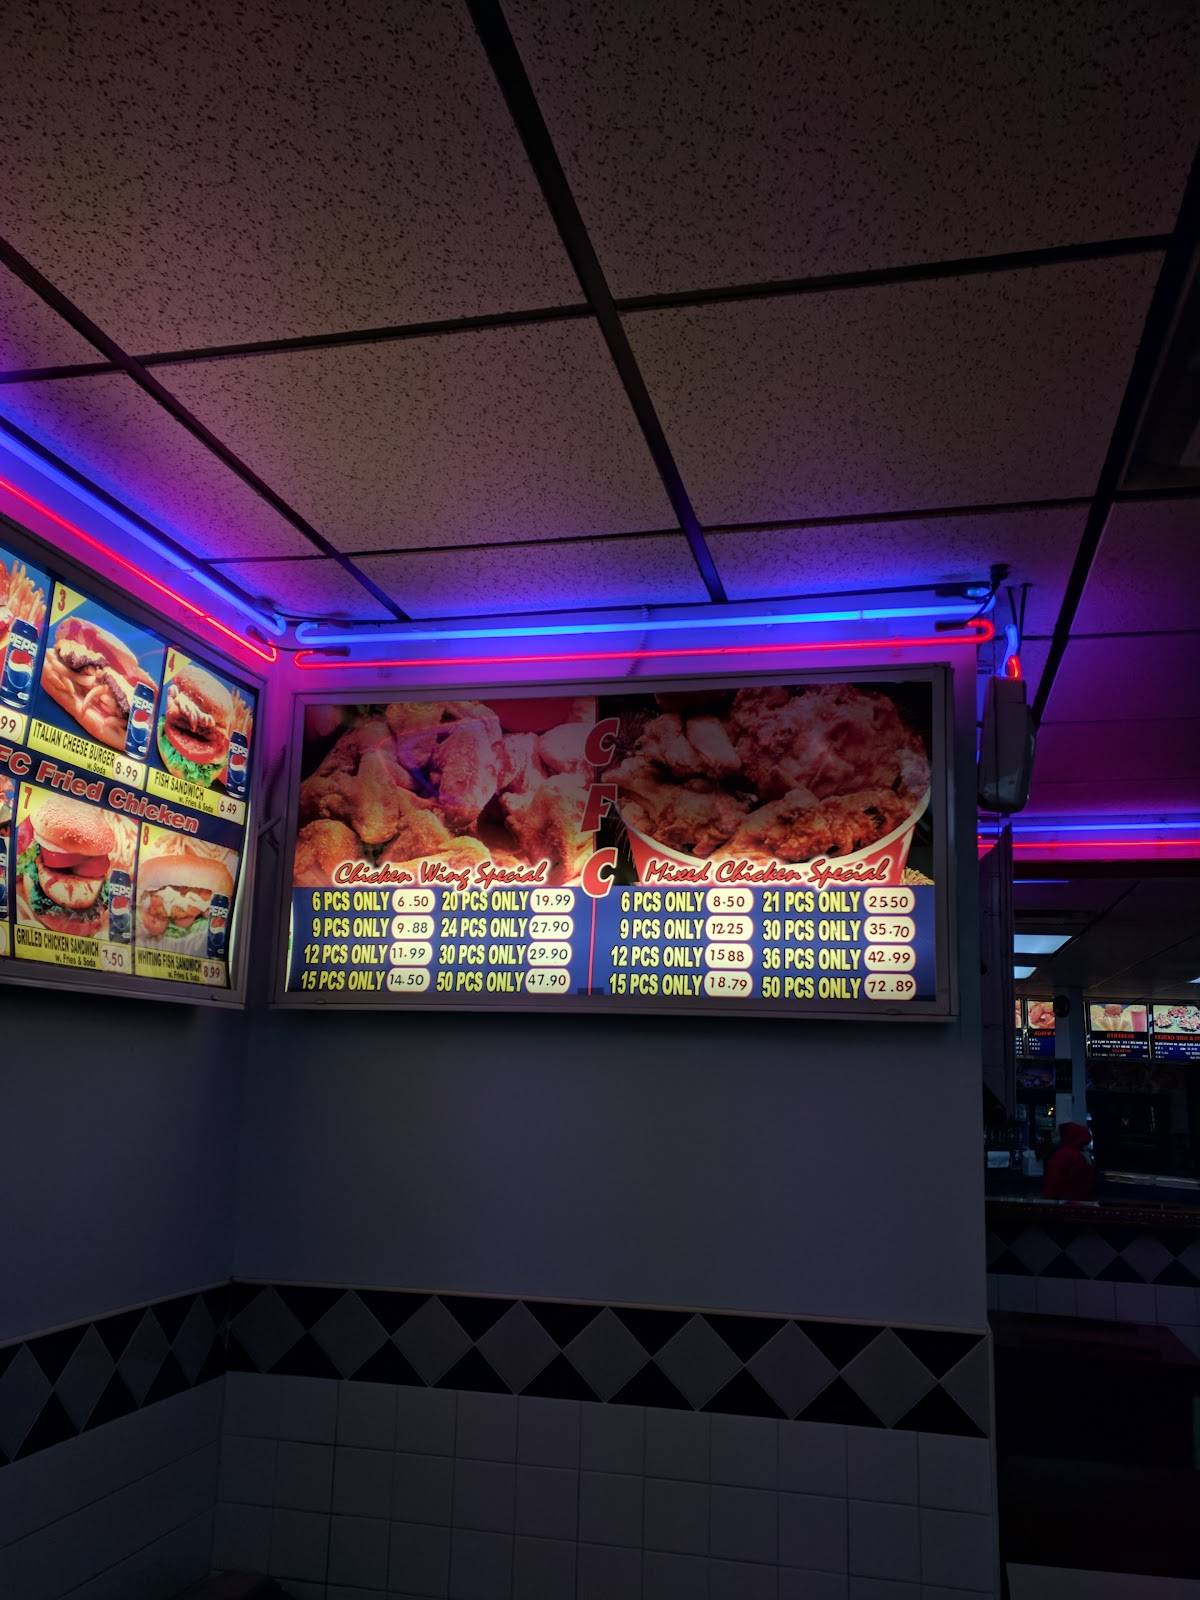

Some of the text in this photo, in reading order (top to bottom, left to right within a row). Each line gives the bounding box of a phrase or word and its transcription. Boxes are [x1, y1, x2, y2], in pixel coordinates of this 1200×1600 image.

[58, 588, 67, 612] 3
[9, 632, 39, 657] PEPS
[168, 653, 176, 673] 4
[133, 695, 153, 715] PEPS
[33, 721, 115, 768] ITALIAN CHEESE BURGER
[230, 741, 248, 758] PEPS
[115, 761, 138, 782] 8.99
[154, 771, 204, 801] FISH SANDWICH
[24, 786, 32, 810] 7
[36, 760, 105, 802] Fried
[108, 787, 200, 834] Chicken
[143, 826, 149, 846] 8
[334, 860, 548, 891] Chicken Wing Special
[645, 858, 890, 889] Mixed Chicken Special
[312, 891, 429, 911] 6 PCS ONLY 6.50
[442, 891, 571, 911] 20 PCS ONLY 19.99
[621, 892, 745, 912] 6 PCS ONLY 8.50
[762, 891, 780, 912] 21
[784, 891, 815, 912] PCS
[818, 891, 861, 912] ONLY
[312, 918, 428, 938] 9 PCS ONLY 9.88
[440, 918, 570, 938] 24 PCS ONLY 27.90
[620, 919, 629, 939] 9
[632, 919, 660, 939] PCS
[664, 919, 704, 939] ONLY
[762, 919, 910, 942] 30 PCS ONLY 35.70
[16, 928, 99, 957] GRILLED CHICKEN SANDWICH
[102, 949, 125, 968] 7.50
[162, 953, 175, 969] FISH
[304, 944, 426, 964] 12 PCS ONLY 11.99
[439, 944, 568, 965] 30 PCS ONLY 29.90
[611, 946, 628, 967] 12
[631, 946, 660, 967] PCS
[663, 946, 704, 968] ONLY
[762, 948, 911, 970] 36 PCS ONLY 42.99
[301, 971, 424, 990] 15 PCS ONLY 14.50
[436, 972, 566, 992] 50 PCS ONLY 47.90
[609, 973, 748, 996] 15 PCS ONLY 18.79
[761, 976, 914, 999] 50 PCS ONLY 72.89
